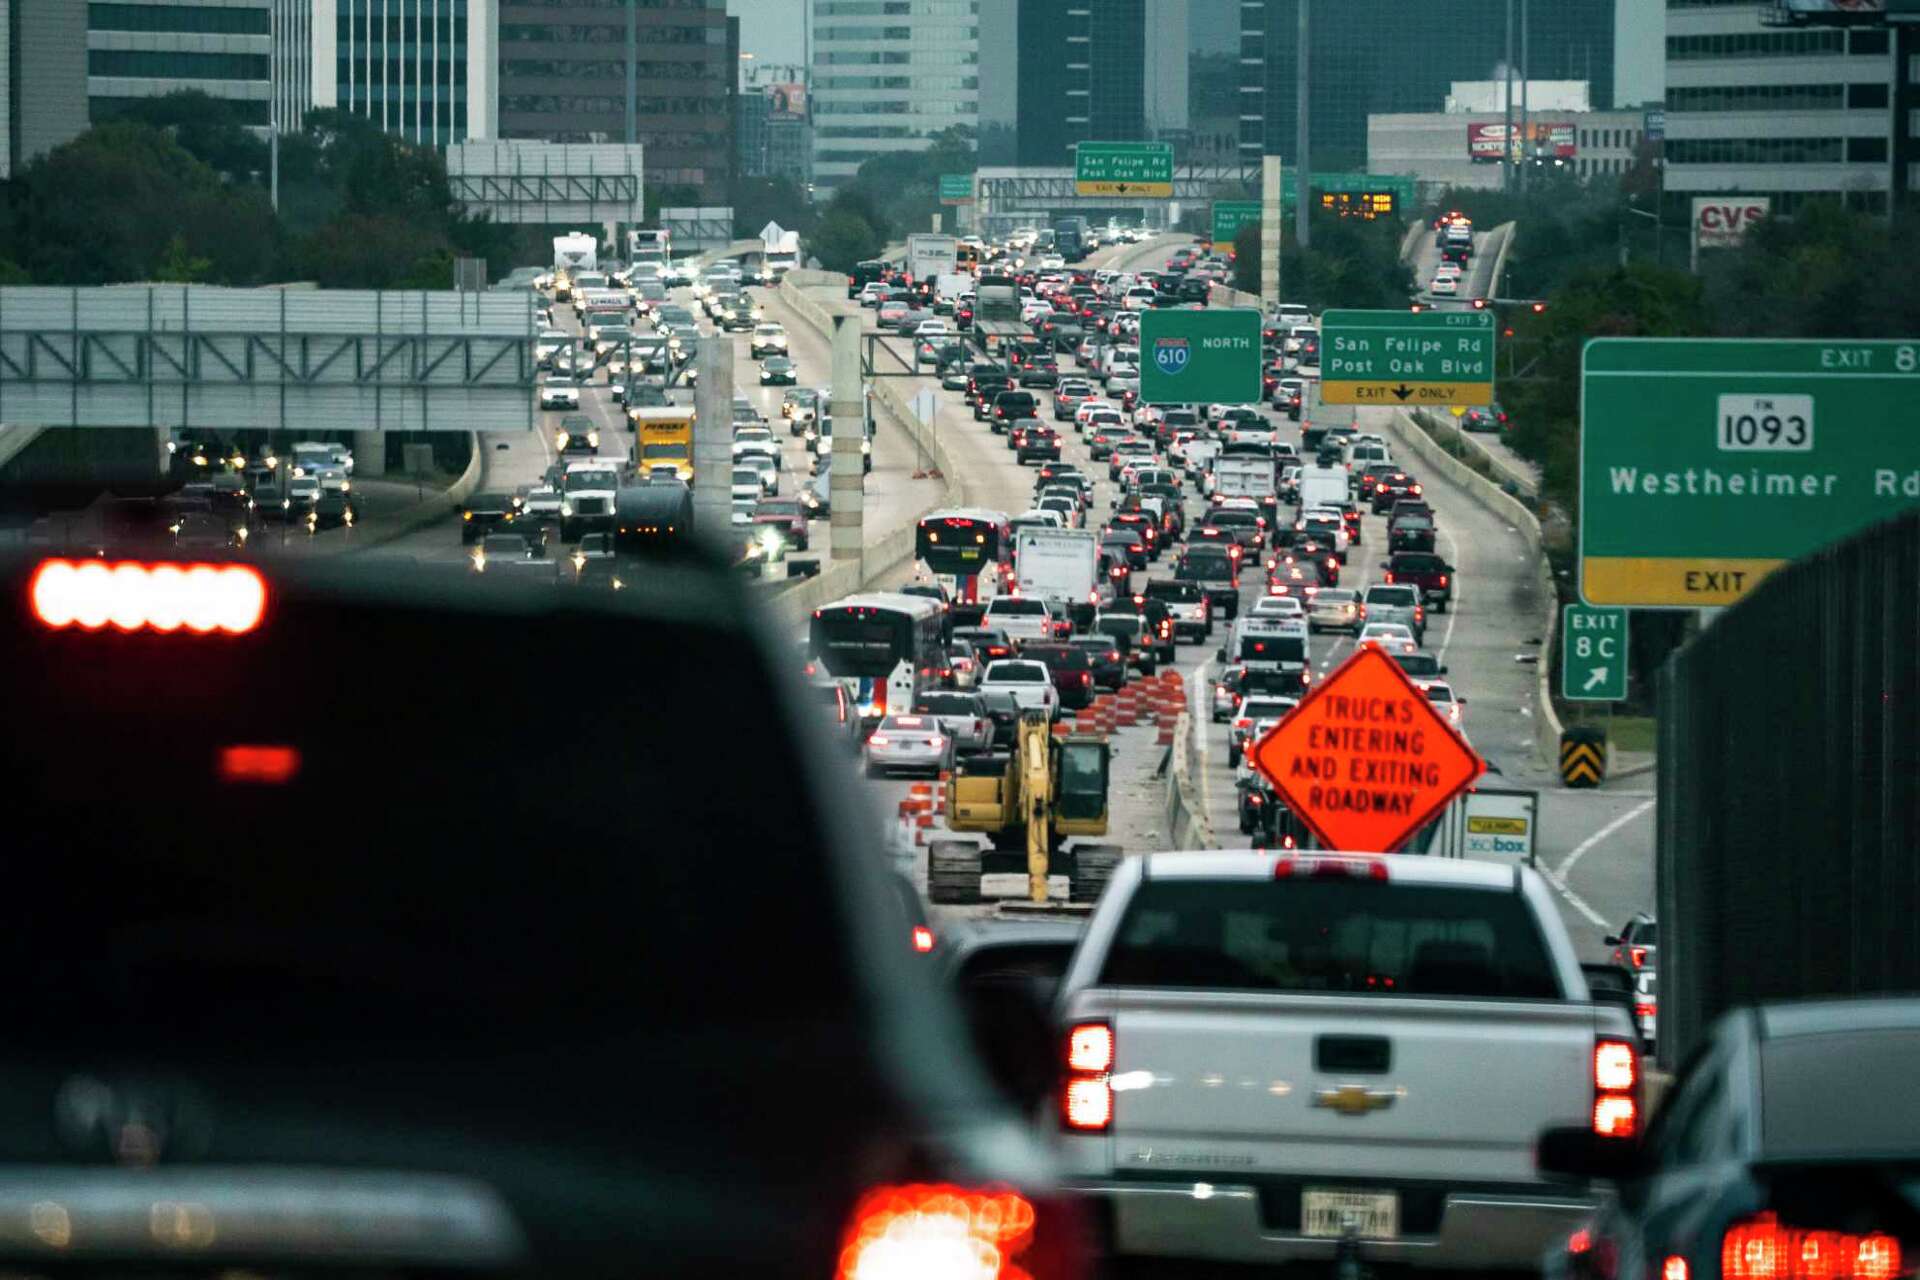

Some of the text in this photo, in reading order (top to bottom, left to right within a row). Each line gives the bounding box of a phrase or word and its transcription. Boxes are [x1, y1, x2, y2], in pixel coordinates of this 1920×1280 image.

[1084, 156, 1105, 166] San
[1111, 156, 1144, 168] Felipe
[1082, 168, 1168, 178] Post Oak Blvd
[1701, 205, 1764, 229] CVS
[1446, 312, 1489, 326] EXIT 9
[1202, 337, 1250, 348] NORTH
[1334, 336, 1482, 355] San Felipe Rd
[1157, 348, 1187, 364] 610
[1820, 348, 1873, 367] EXIT
[1331, 359, 1484, 374] Post Oak Blvd
[1355, 386, 1457, 399] EXIT ONLY
[1724, 415, 1808, 447] 1093
[1609, 466, 1920, 497] Westheimer Rd
[1685, 571, 1747, 593] EXIT
[1572, 613, 1619, 630] EXIT
[1323, 695, 1414, 724] TRUCKS
[1308, 724, 1425, 755] ENTERING
[1290, 756, 1440, 787] AND EXITING
[1309, 785, 1417, 816] ROADWAY
